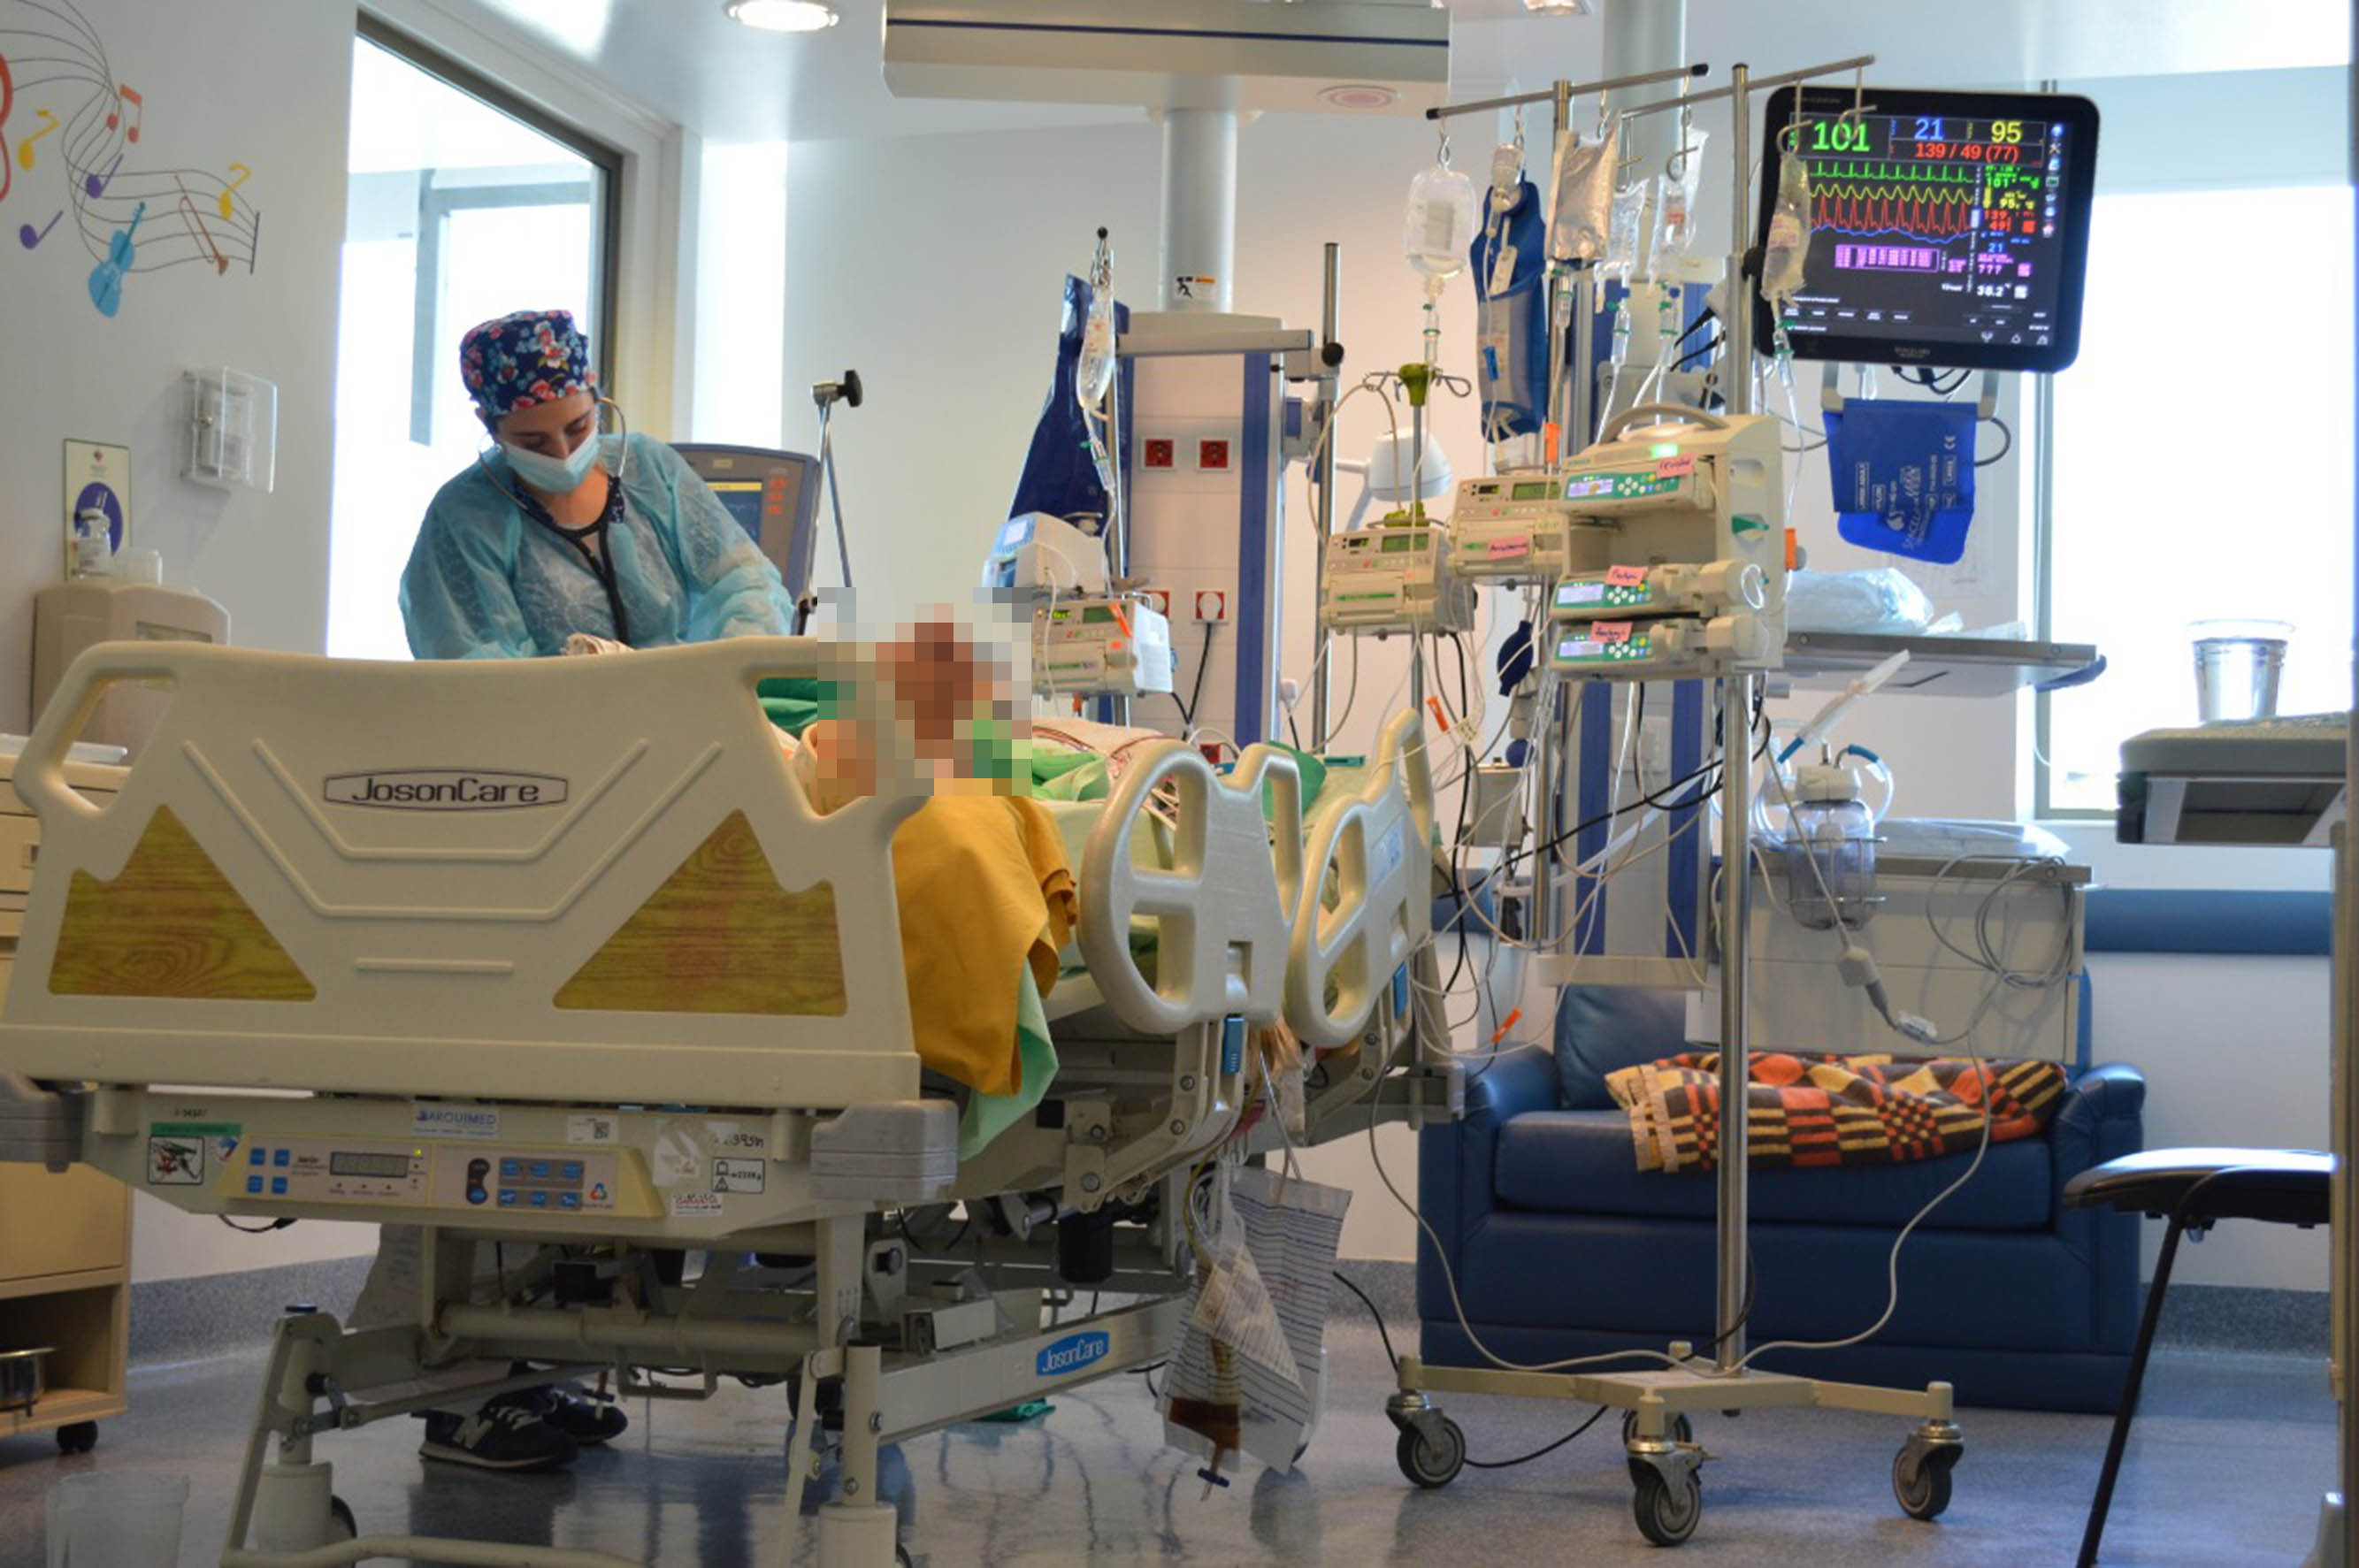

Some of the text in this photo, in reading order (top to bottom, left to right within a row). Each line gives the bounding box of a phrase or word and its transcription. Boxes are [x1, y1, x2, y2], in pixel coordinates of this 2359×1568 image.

[1812, 120, 1871, 152] 101
[1914, 118, 1944, 141] 21
[1990, 120, 2022, 143] 95
[1915, 142, 1946, 159] 139
[1960, 144, 1982, 160] 49
[1986, 144, 2020, 165] (77)
[352, 777, 540, 802] JosonCare
